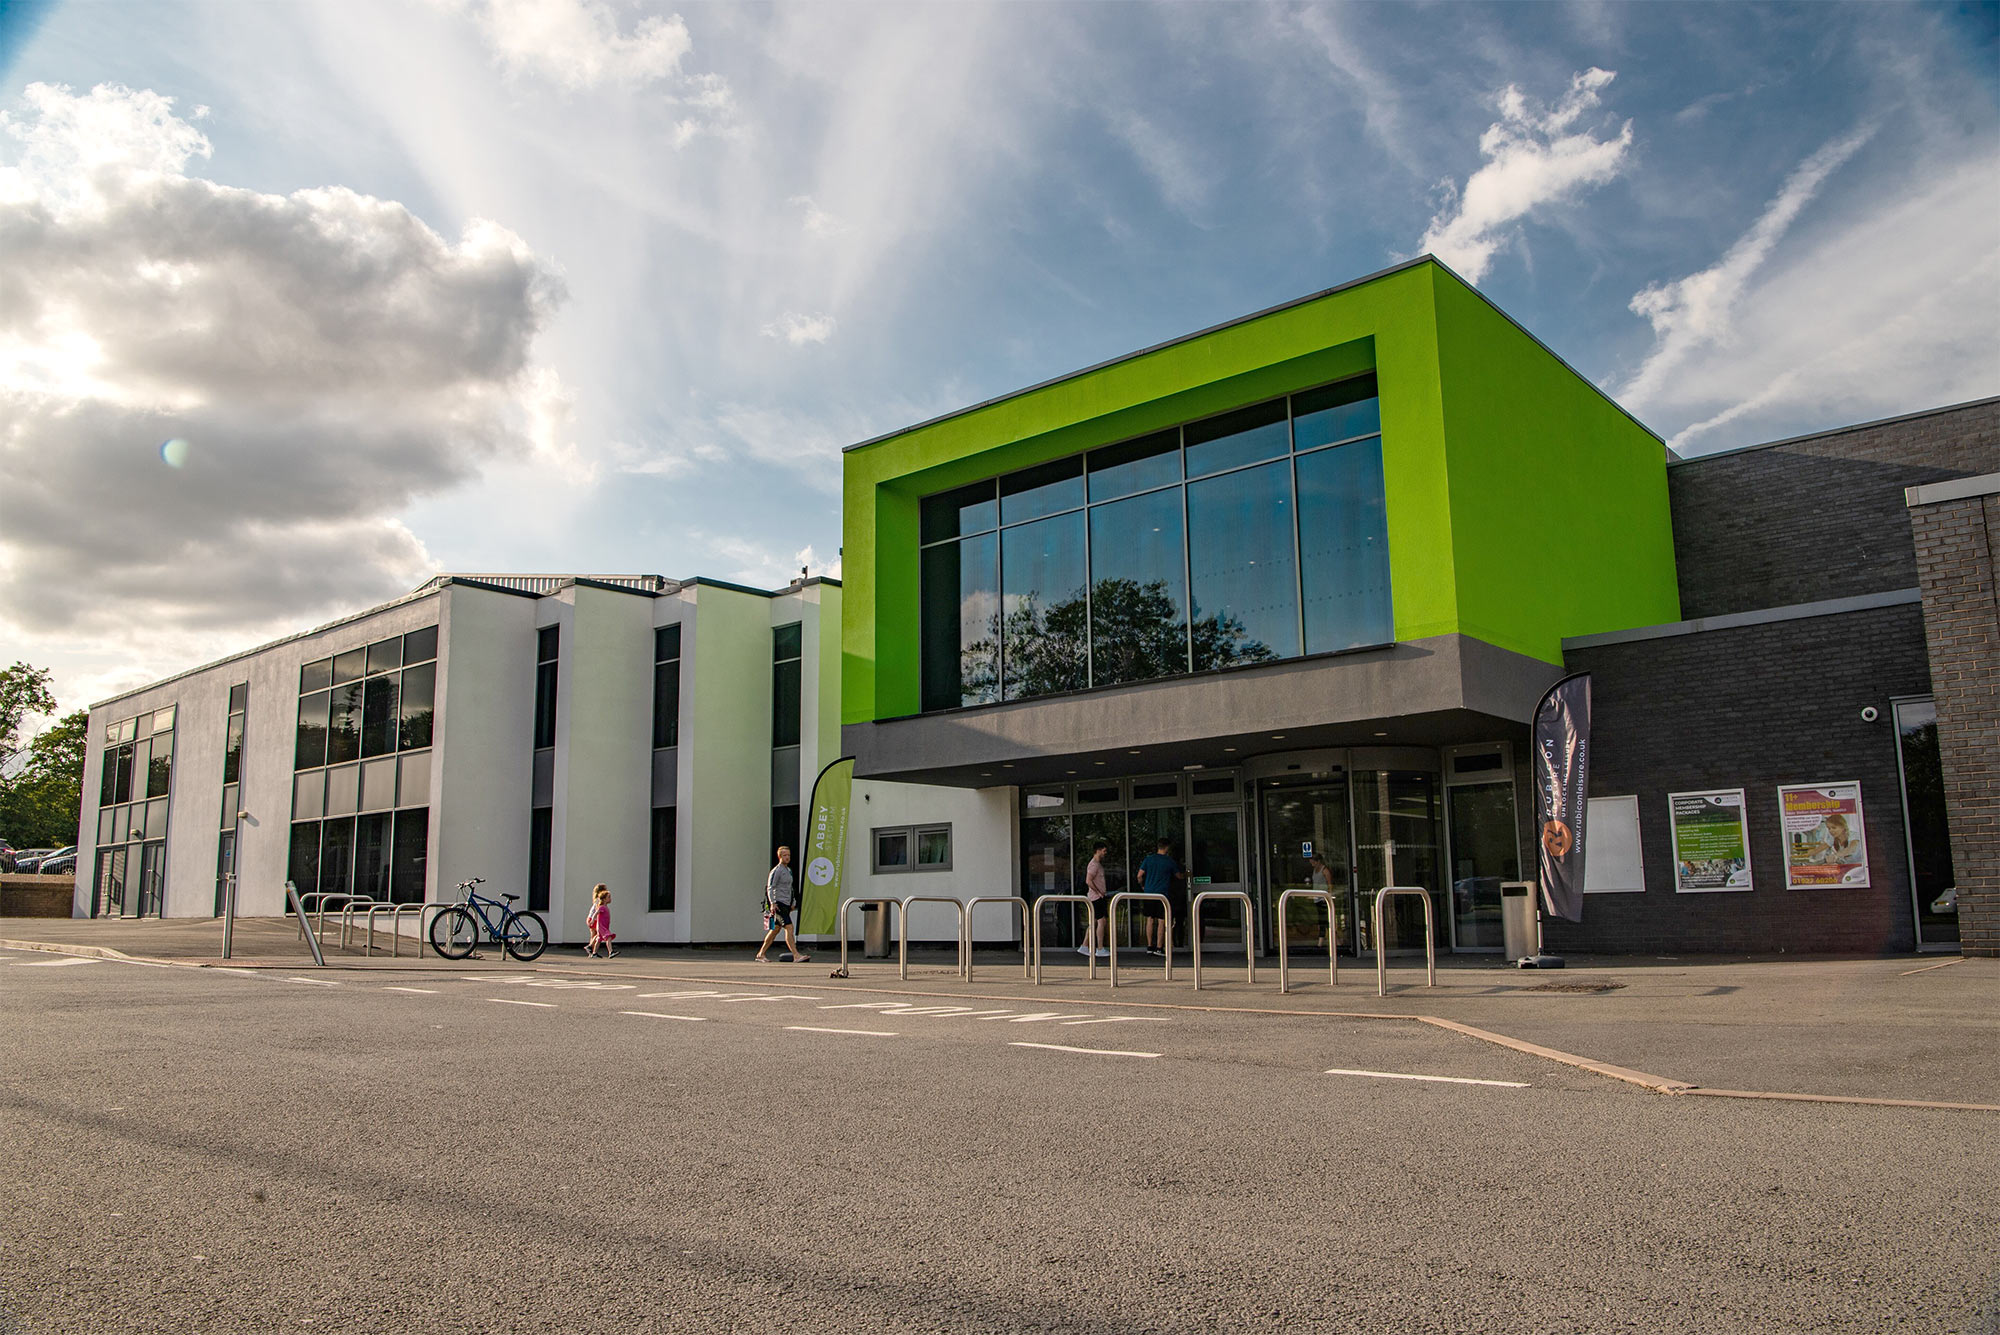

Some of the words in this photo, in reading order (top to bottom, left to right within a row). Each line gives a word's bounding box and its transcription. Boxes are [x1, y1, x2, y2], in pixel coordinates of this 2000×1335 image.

[1545, 739, 1554, 817] RUBICON
[1575, 738, 1586, 854] www.rubiconleisure.co.uk
[1784, 793, 1798, 801] 11+
[1785, 800, 1840, 811] Membership
[816, 806, 828, 850] ABBEY
[825, 806, 835, 850] STADIUM
[461, 975, 636, 990] DROP
[637, 990, 820, 1002] OFF
[816, 1002, 1170, 1025] POINT
